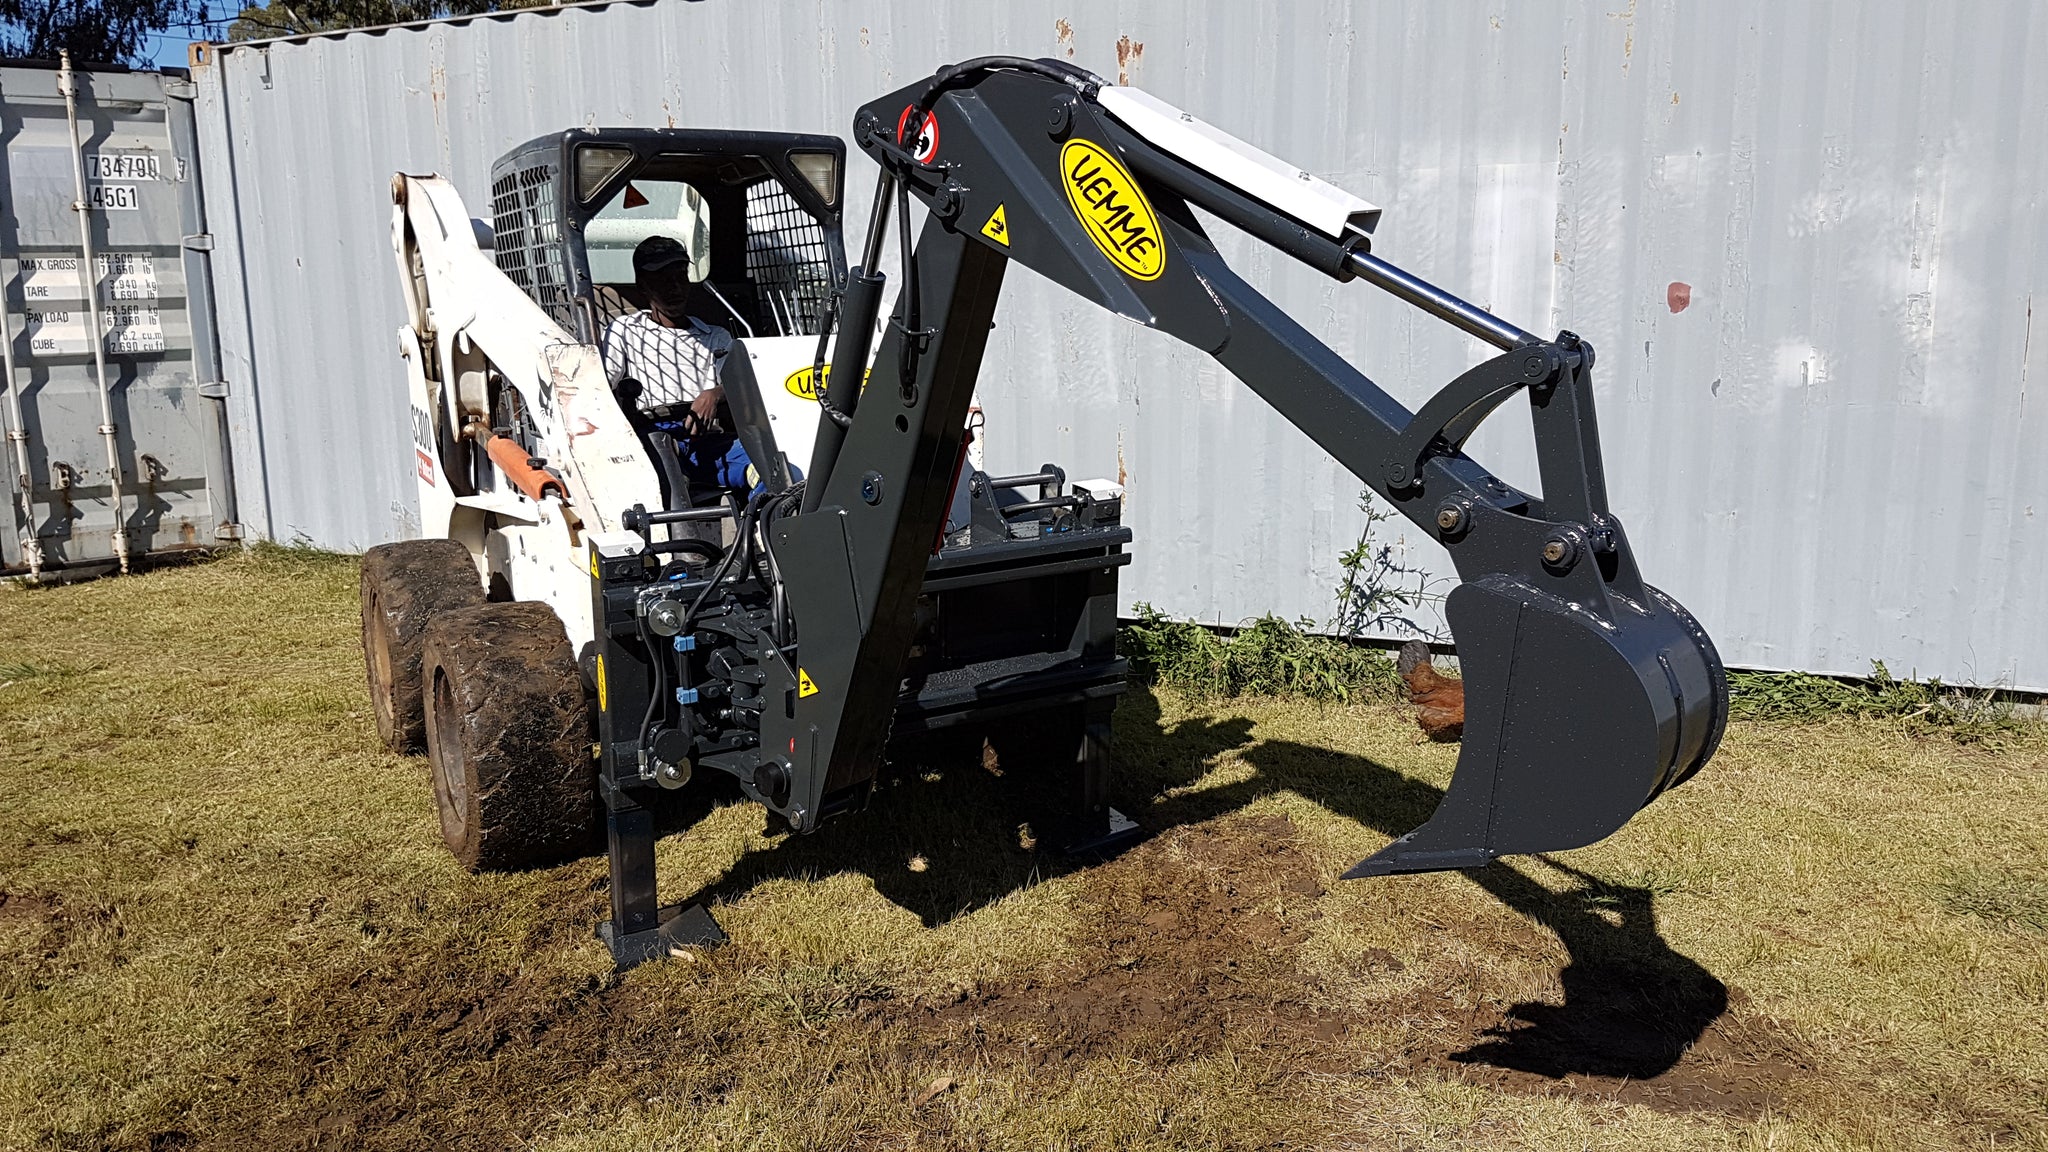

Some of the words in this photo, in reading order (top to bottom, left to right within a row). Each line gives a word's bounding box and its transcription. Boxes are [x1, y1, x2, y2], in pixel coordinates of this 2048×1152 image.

[89, 156, 158, 178] 734790
[93, 186, 137, 208] 45G1
[47, 259, 77, 270] GROSS
[99, 253, 133, 264] 32.500
[141, 253, 153, 266] kg
[143, 265, 151, 275] lb
[109, 280, 138, 290] 3.940
[145, 279, 157, 291] kg
[26, 286, 49, 297] TARE
[147, 290, 156, 301] lb
[147, 304, 159, 317] kg
[26, 311, 69, 323] PAYLOAD
[148, 316, 157, 326] lb
[32, 339, 55, 350] CUBE
